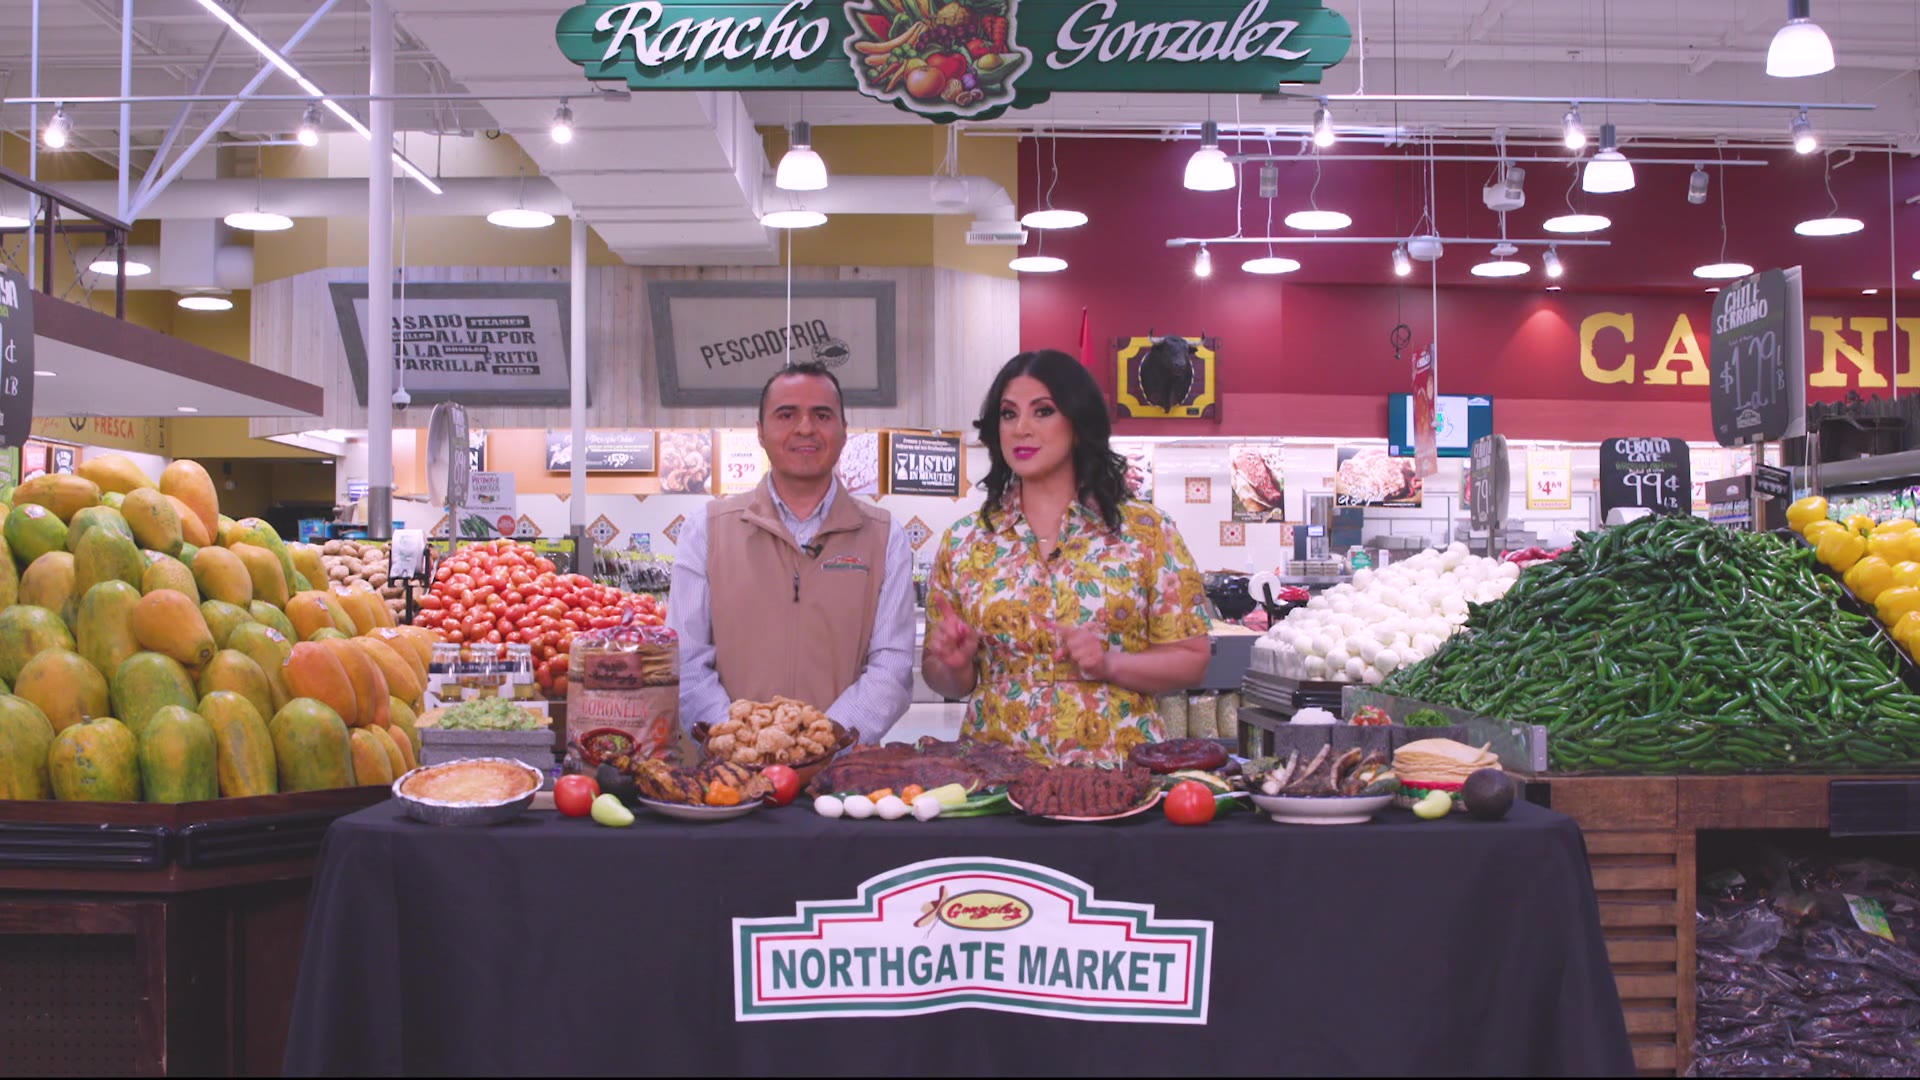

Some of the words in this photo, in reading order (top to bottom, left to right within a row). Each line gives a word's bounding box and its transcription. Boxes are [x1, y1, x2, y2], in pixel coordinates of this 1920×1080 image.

[595, 0, 830, 66] Rancho
[1046, 0, 1312, 70] Gonzalez
[469, 318, 525, 327] STEAMED
[1717, 299, 1768, 335] SERRANO
[436, 330, 462, 343] AL
[466, 331, 536, 345] VAPOR
[700, 319, 830, 370] PESCADERIA
[414, 344, 442, 358] LA
[484, 351, 538, 364] FRITO
[498, 367, 534, 375] FRIED
[95, 418, 135, 439] FRESCA
[909, 453, 953, 473] LISTO
[947, 902, 1022, 921] Gonzalez
[771, 941, 1006, 990] NORTHGATE
[1018, 944, 1176, 993] MARKET
